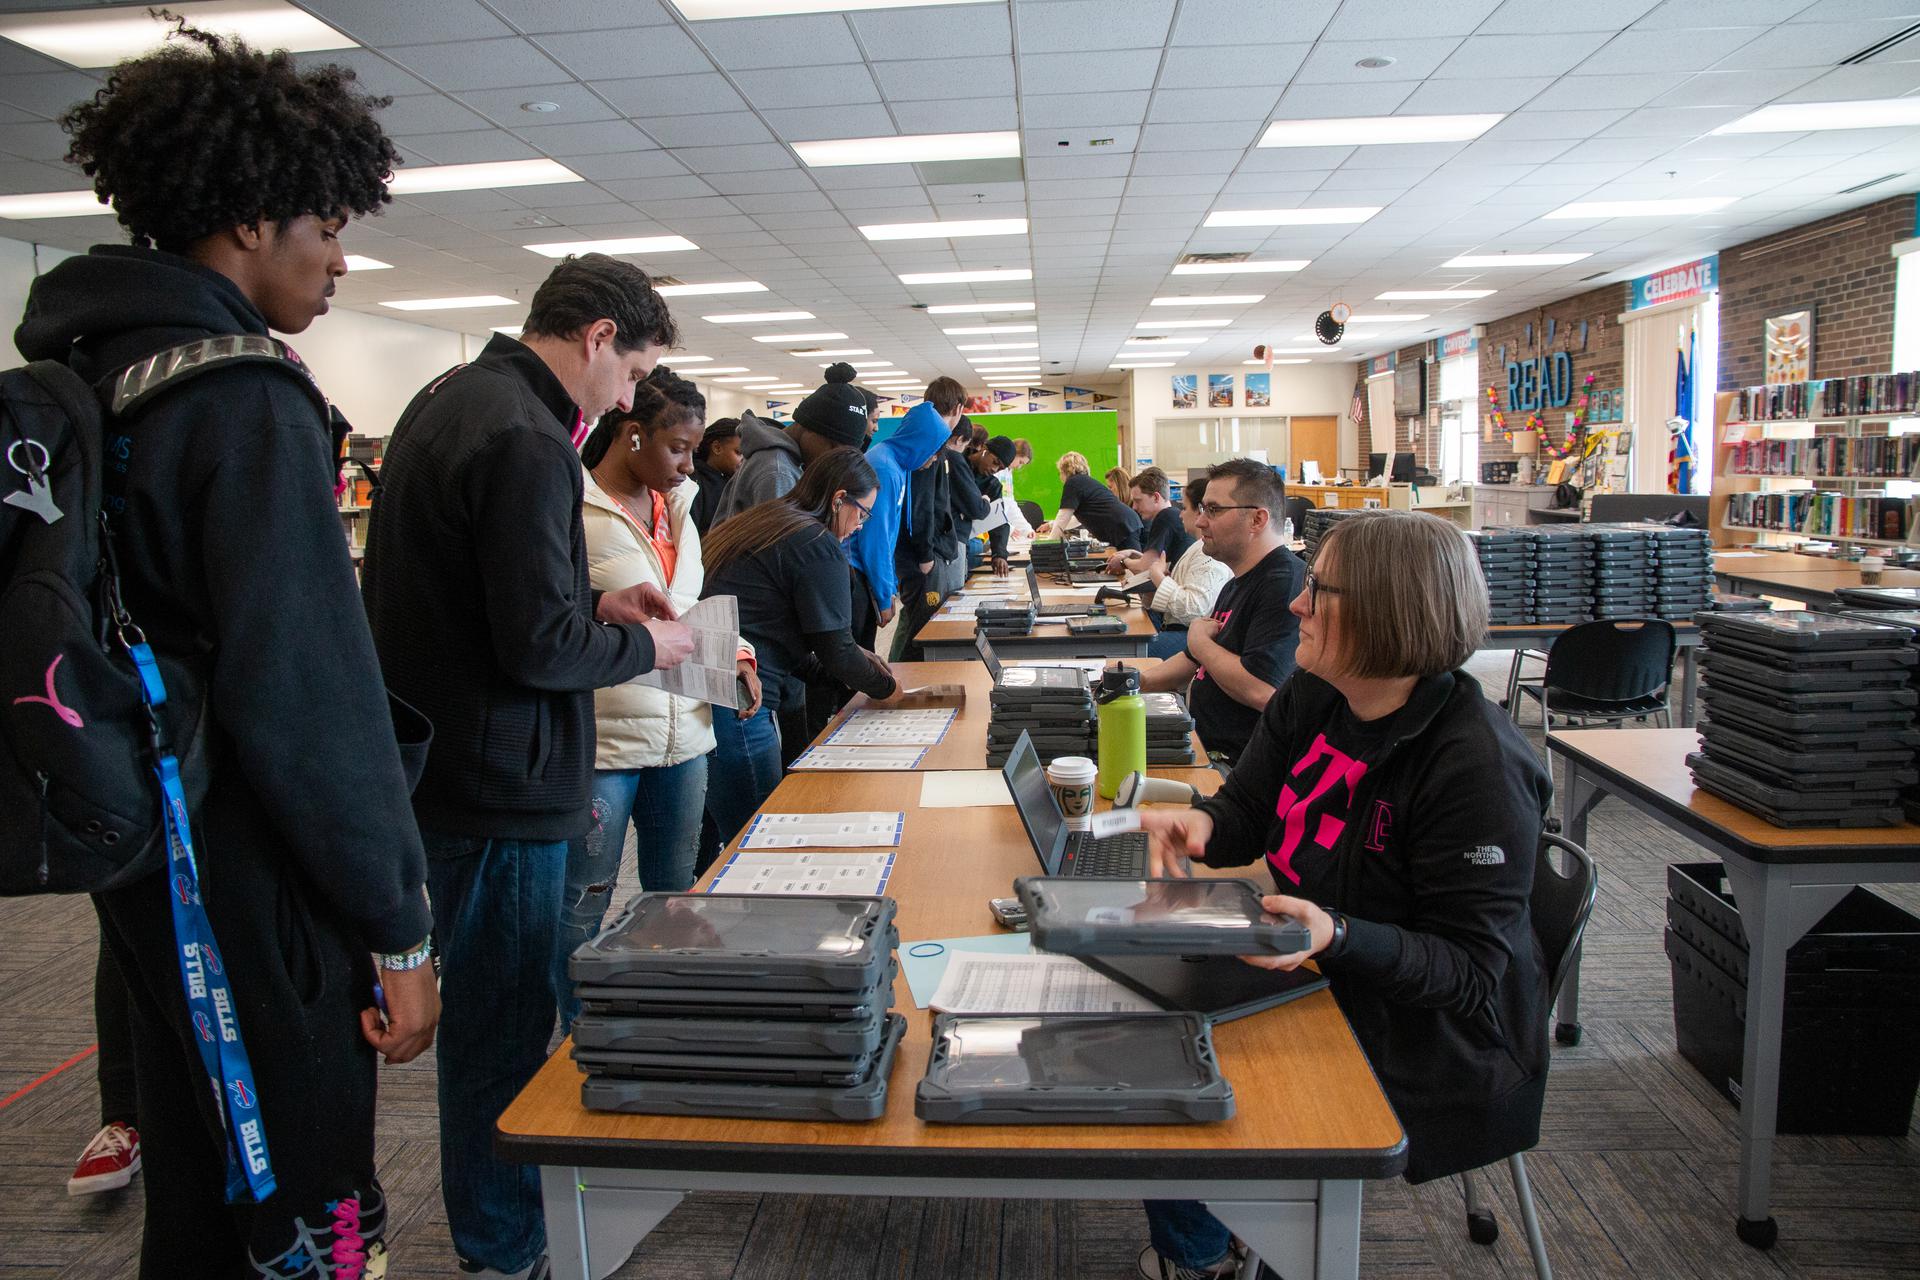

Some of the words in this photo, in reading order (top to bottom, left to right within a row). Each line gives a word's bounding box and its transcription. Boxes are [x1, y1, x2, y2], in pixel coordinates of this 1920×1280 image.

[1644, 263, 1711, 301] CELEBRATE
[1506, 352, 1573, 412] READ
[1475, 845, 1492, 853] THE
[184, 942, 207, 999] BILLS
[211, 987, 237, 1042] BILLS
[240, 1119, 268, 1175] BILLS
